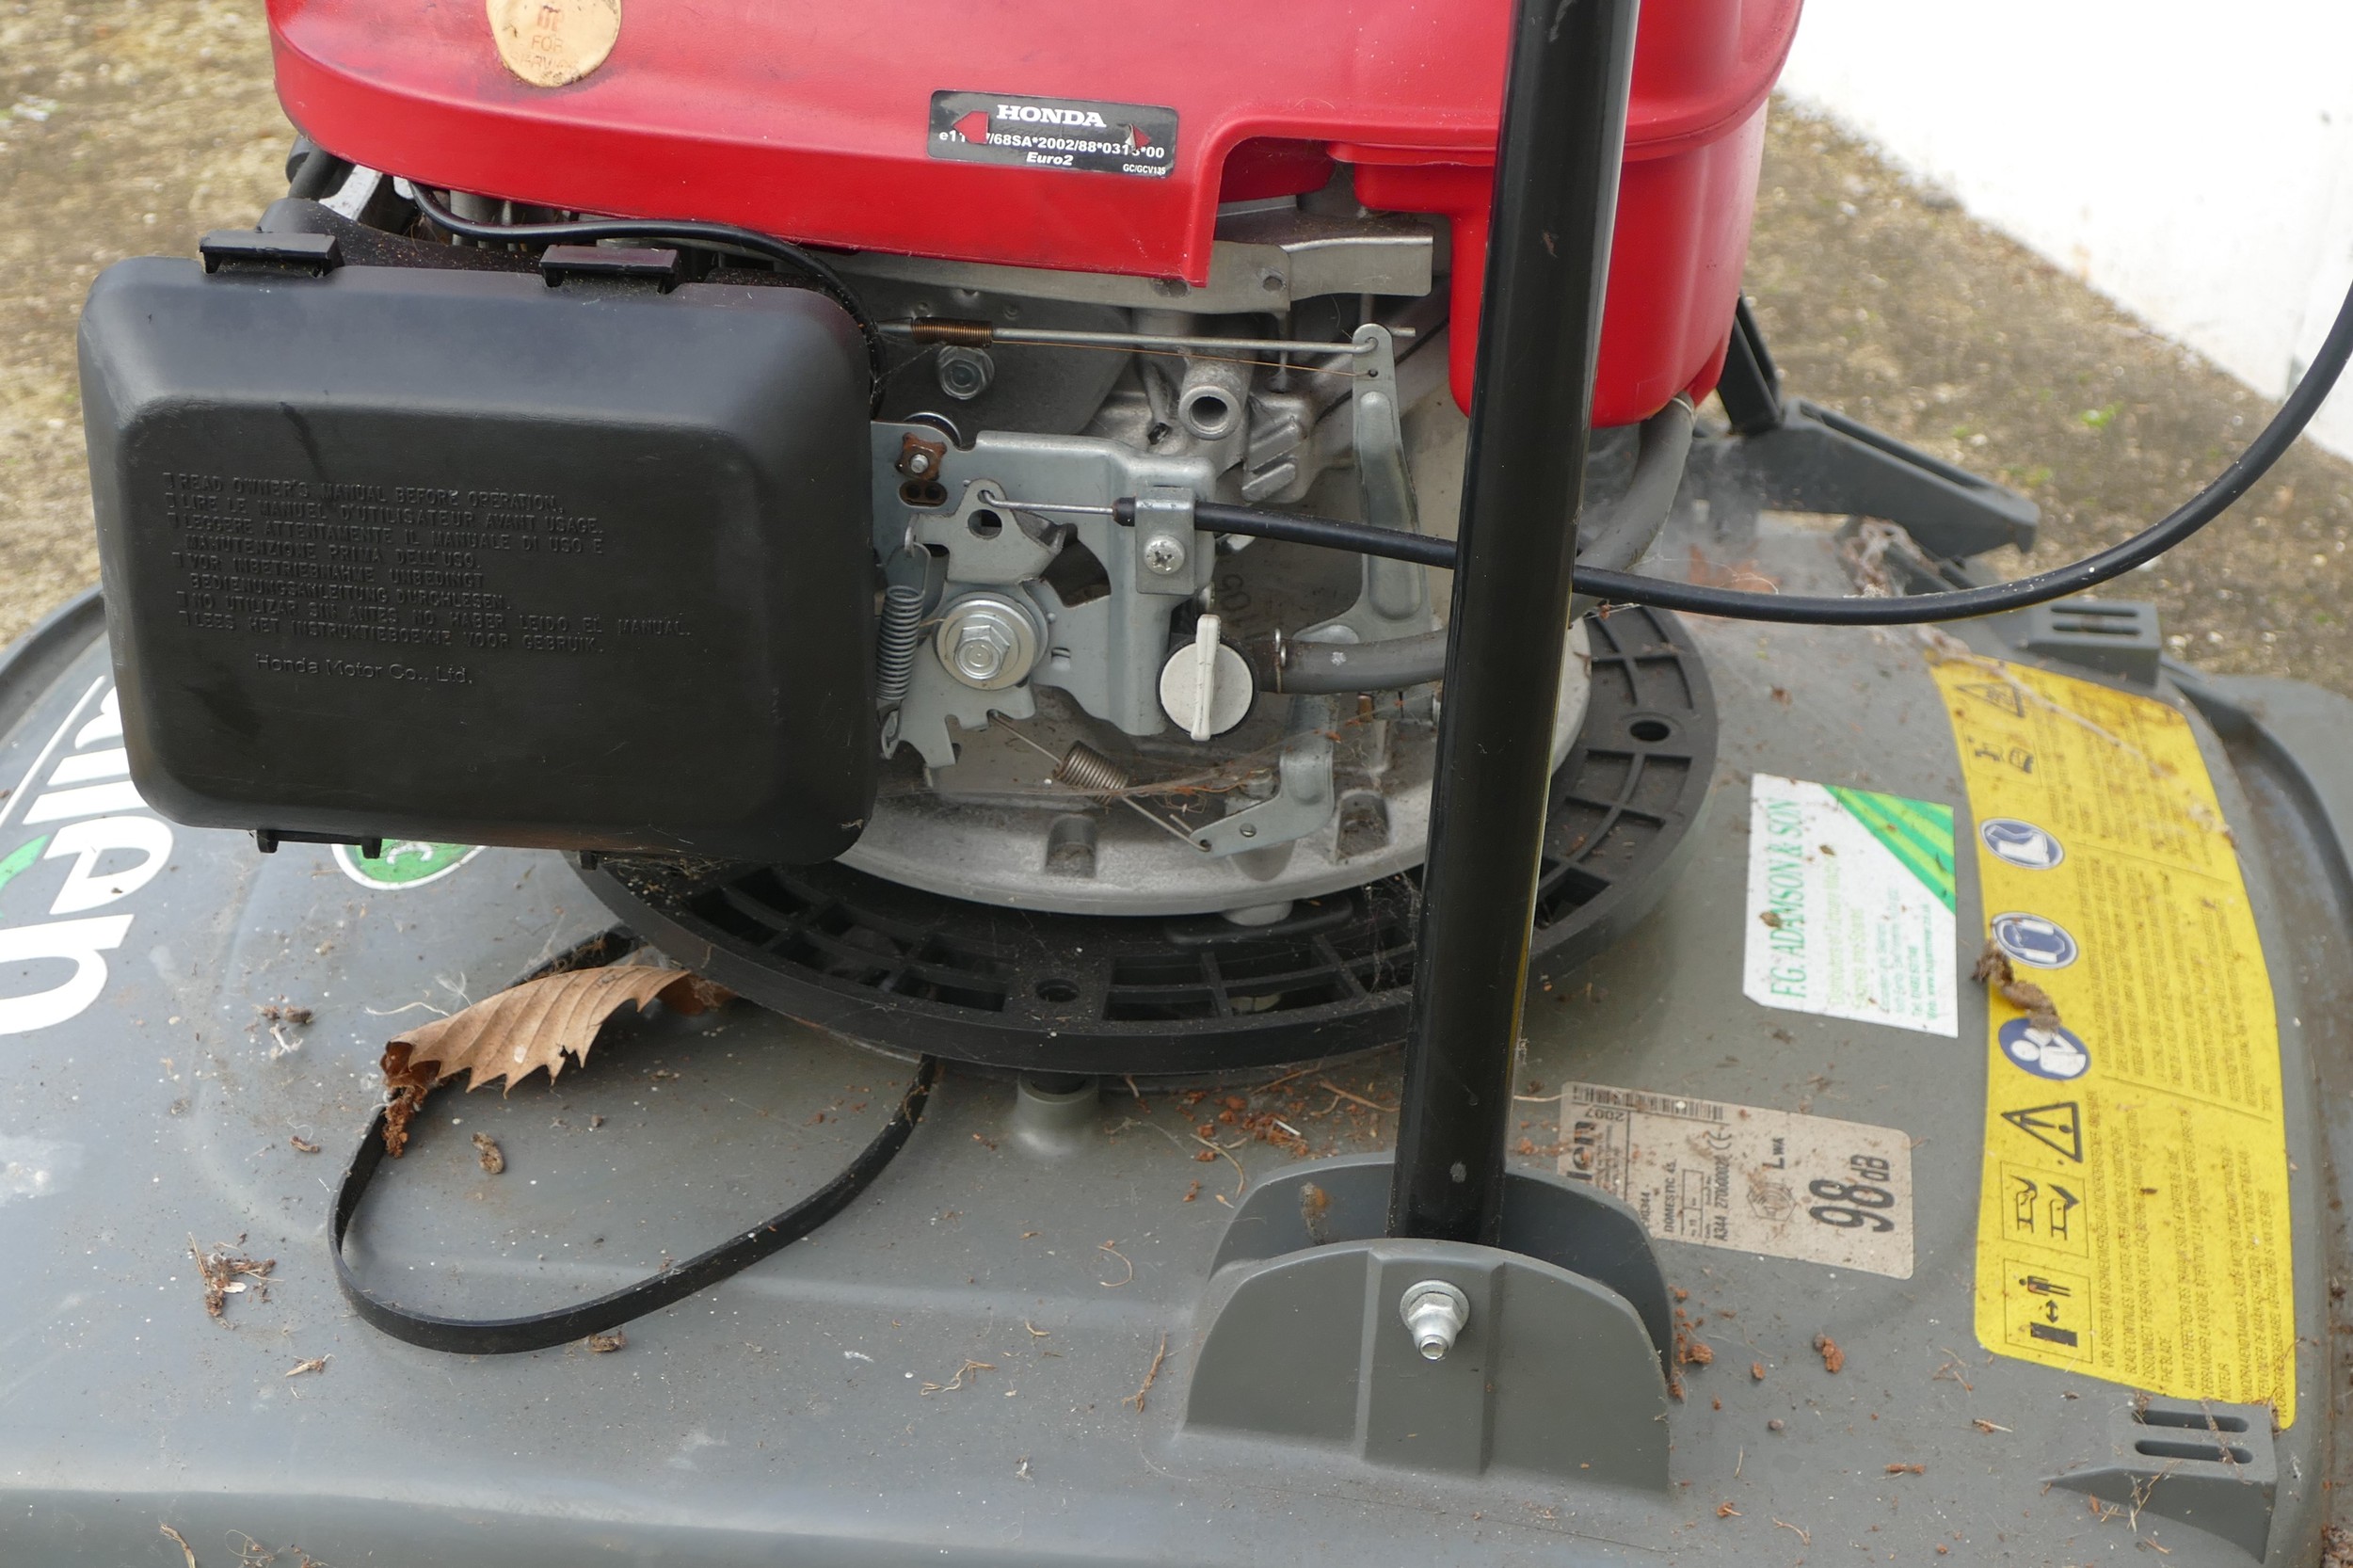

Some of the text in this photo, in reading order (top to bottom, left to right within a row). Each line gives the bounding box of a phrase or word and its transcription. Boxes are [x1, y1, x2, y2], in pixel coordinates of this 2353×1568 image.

[997, 104, 1107, 128] HONDA
[1026, 152, 1074, 167] Euro2
[179, 473, 222, 492] READ
[233, 477, 310, 498] OWNER'S
[322, 483, 387, 503] MANUAL
[395, 487, 458, 506] BEFORE
[181, 494, 217, 513] LIRE
[228, 497, 248, 514] LE
[257, 500, 327, 519] MANUEL
[486, 512, 535, 531] AVANT
[185, 514, 603, 554] LEGGERE ATTENTAMENTE IL MANUALE DI USO E
[186, 534, 316, 559] MANUTENZIONE
[329, 544, 382, 564] PRIMA
[187, 552, 221, 570] VOR
[390, 568, 483, 588] UNBEDINGT
[195, 613, 234, 630] LEES
[248, 617, 280, 633] HET
[463, 632, 509, 648] VOOR
[226, 596, 298, 617] UTILIZAR
[309, 601, 338, 618] SIN
[451, 612, 504, 630] HABER
[520, 615, 569, 632] LEIDO
[583, 616, 602, 633] EL
[256, 653, 472, 684] Honda Motor Co., Ltd.
[1768, 800, 1806, 999] F.G. ADAMSON & SON
[1585, 1108, 1625, 1122] 2007
[1566, 1121, 1596, 1181] len
[1664, 1177, 1675, 1233] DOMESTIC
[1809, 1154, 1895, 1233] 98 dB
[1713, 1215, 1728, 1241] A344
